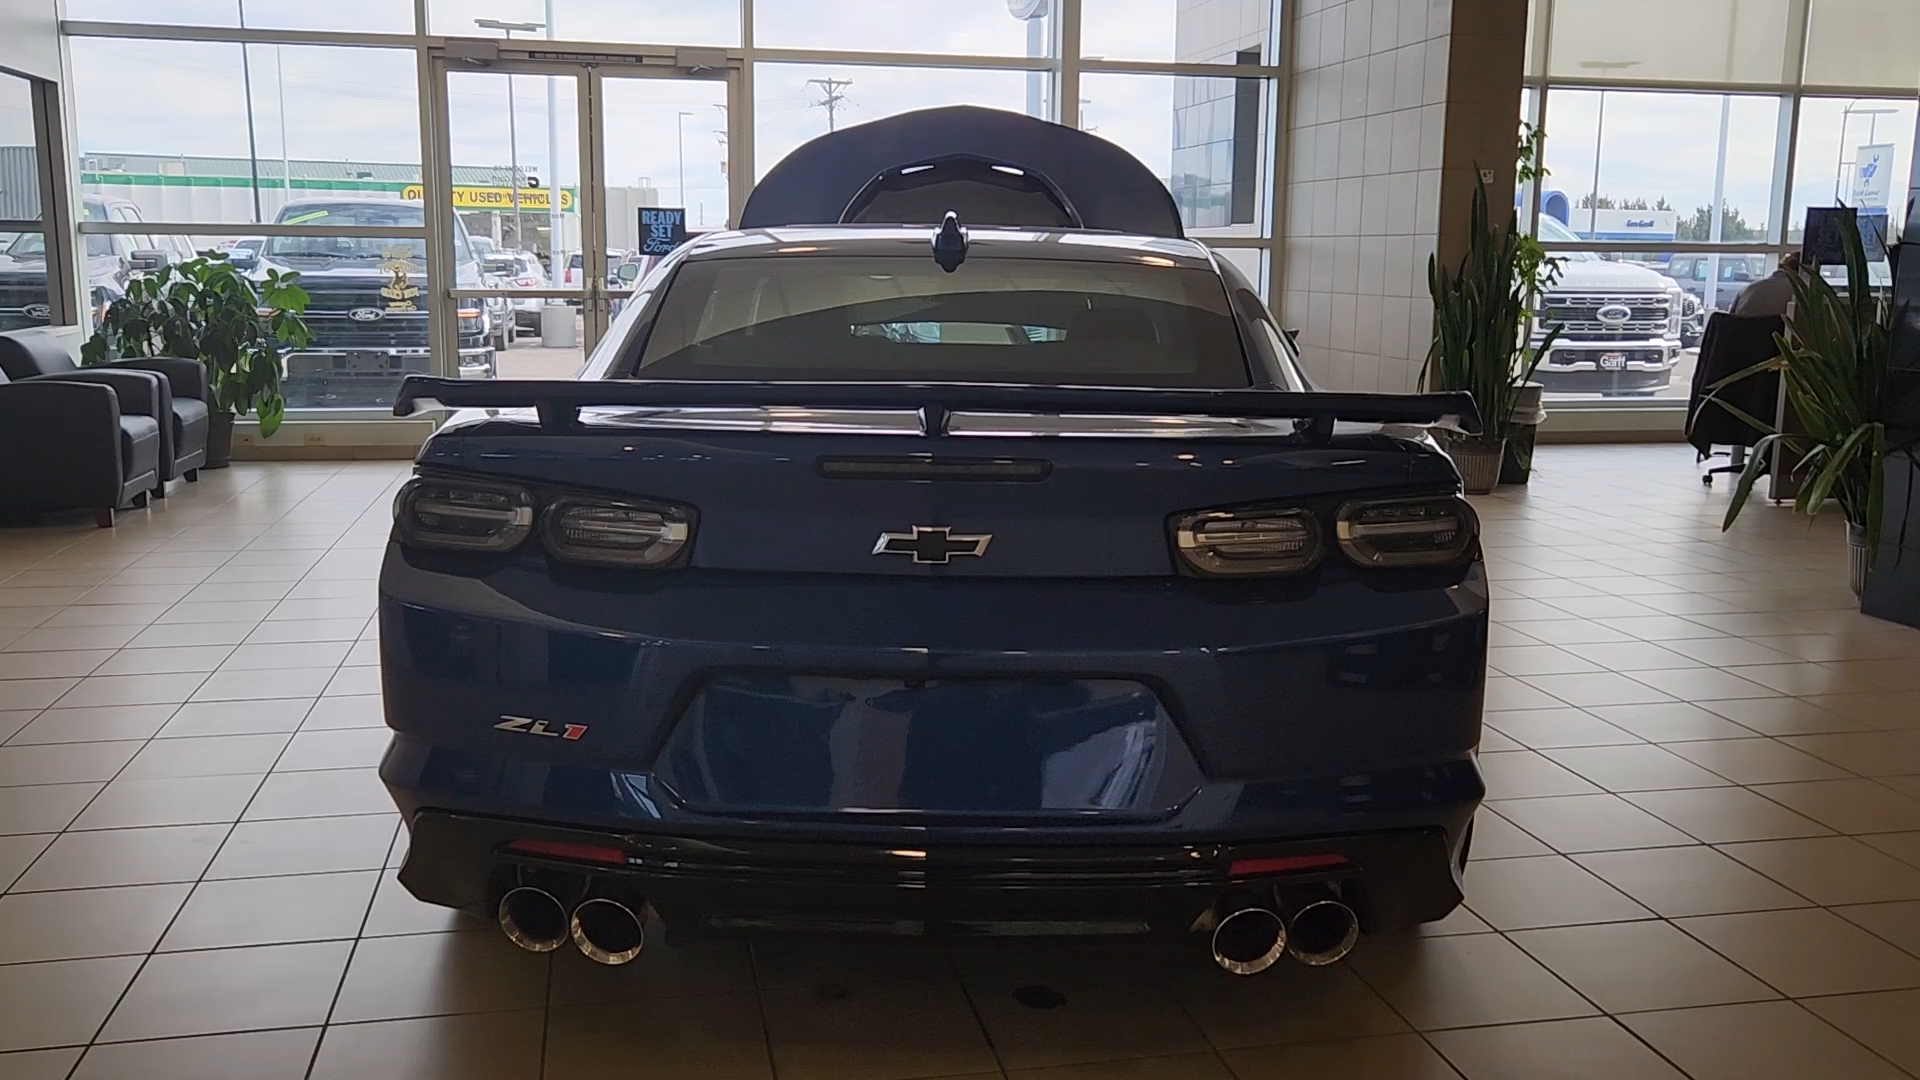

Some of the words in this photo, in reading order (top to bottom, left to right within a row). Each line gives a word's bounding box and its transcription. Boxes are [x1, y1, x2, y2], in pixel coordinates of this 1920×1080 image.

[469, 192, 502, 203] USED
[506, 193, 569, 205] VEHICLS
[642, 211, 682, 225] READY
[650, 224, 673, 238] SET
[643, 238, 681, 252] Ford
[1600, 355, 1626, 368] Garff
[494, 715, 588, 740] ZL1
